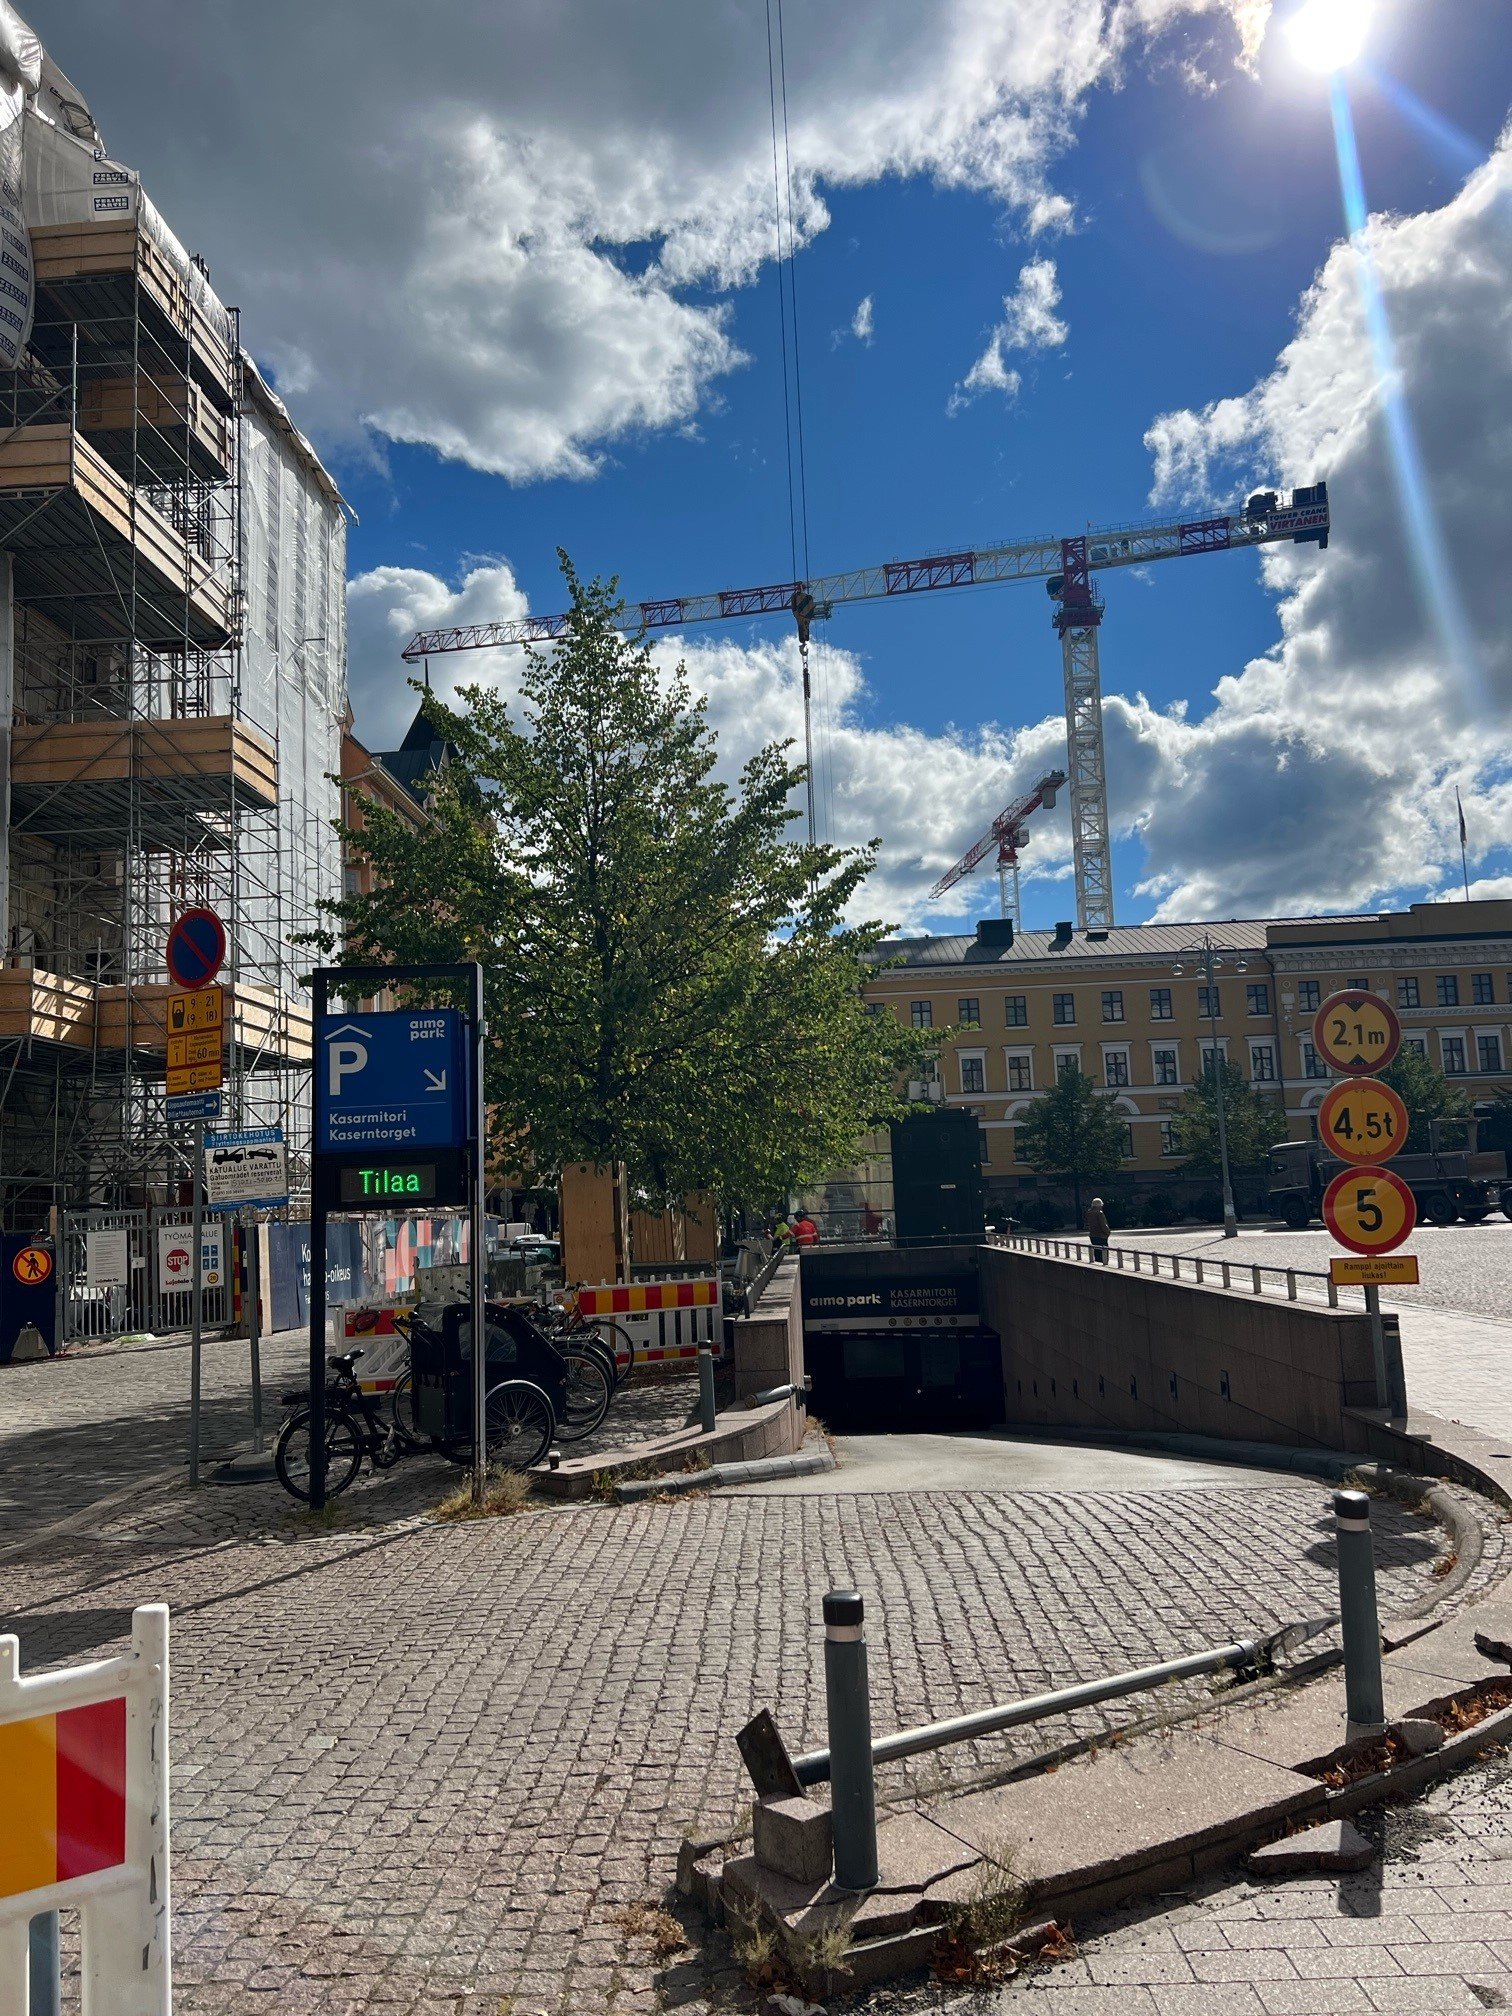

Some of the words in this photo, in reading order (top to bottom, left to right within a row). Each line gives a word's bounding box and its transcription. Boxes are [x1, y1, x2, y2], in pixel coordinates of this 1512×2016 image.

[1269, 511, 1298, 521] TOWER
[1300, 507, 1327, 517] CRANE
[1269, 513, 1327, 531] VIRTANEN
[191, 998, 196, 1008] 9
[205, 995, 214, 1007] 21
[205, 1010, 218, 1022] 18)
[409, 1019, 446, 1029] aimo
[410, 1028, 446, 1041] park
[196, 1047, 208, 1059] 60
[208, 1049, 220, 1058] min
[329, 1041, 368, 1096] P
[329, 1110, 407, 1125] Kasarmitori
[210, 1129, 276, 1142] SIIRTOKEHOTUS
[329, 1126, 416, 1141] Kaserntorget
[211, 1137, 276, 1147] Flyttningsuppmaning
[209, 1164, 248, 1175] KATUALUE
[249, 1161, 282, 1171] VARATTU
[250, 1168, 283, 1178] reserverat
[358, 1169, 420, 1195] Tilaa
[1356, 1188, 1384, 1233] 5
[167, 1255, 189, 1266] STOP
[1343, 1262, 1372, 1272] Ramppi
[1374, 1261, 1405, 1271] ajoittain
[1361, 1271, 1387, 1279] liukas!
[890, 1288, 956, 1299] KASARMITORI
[809, 1296, 845, 1307] aimo
[847, 1293, 882, 1308] park
[890, 1297, 958, 1308] KASERNTORGET
